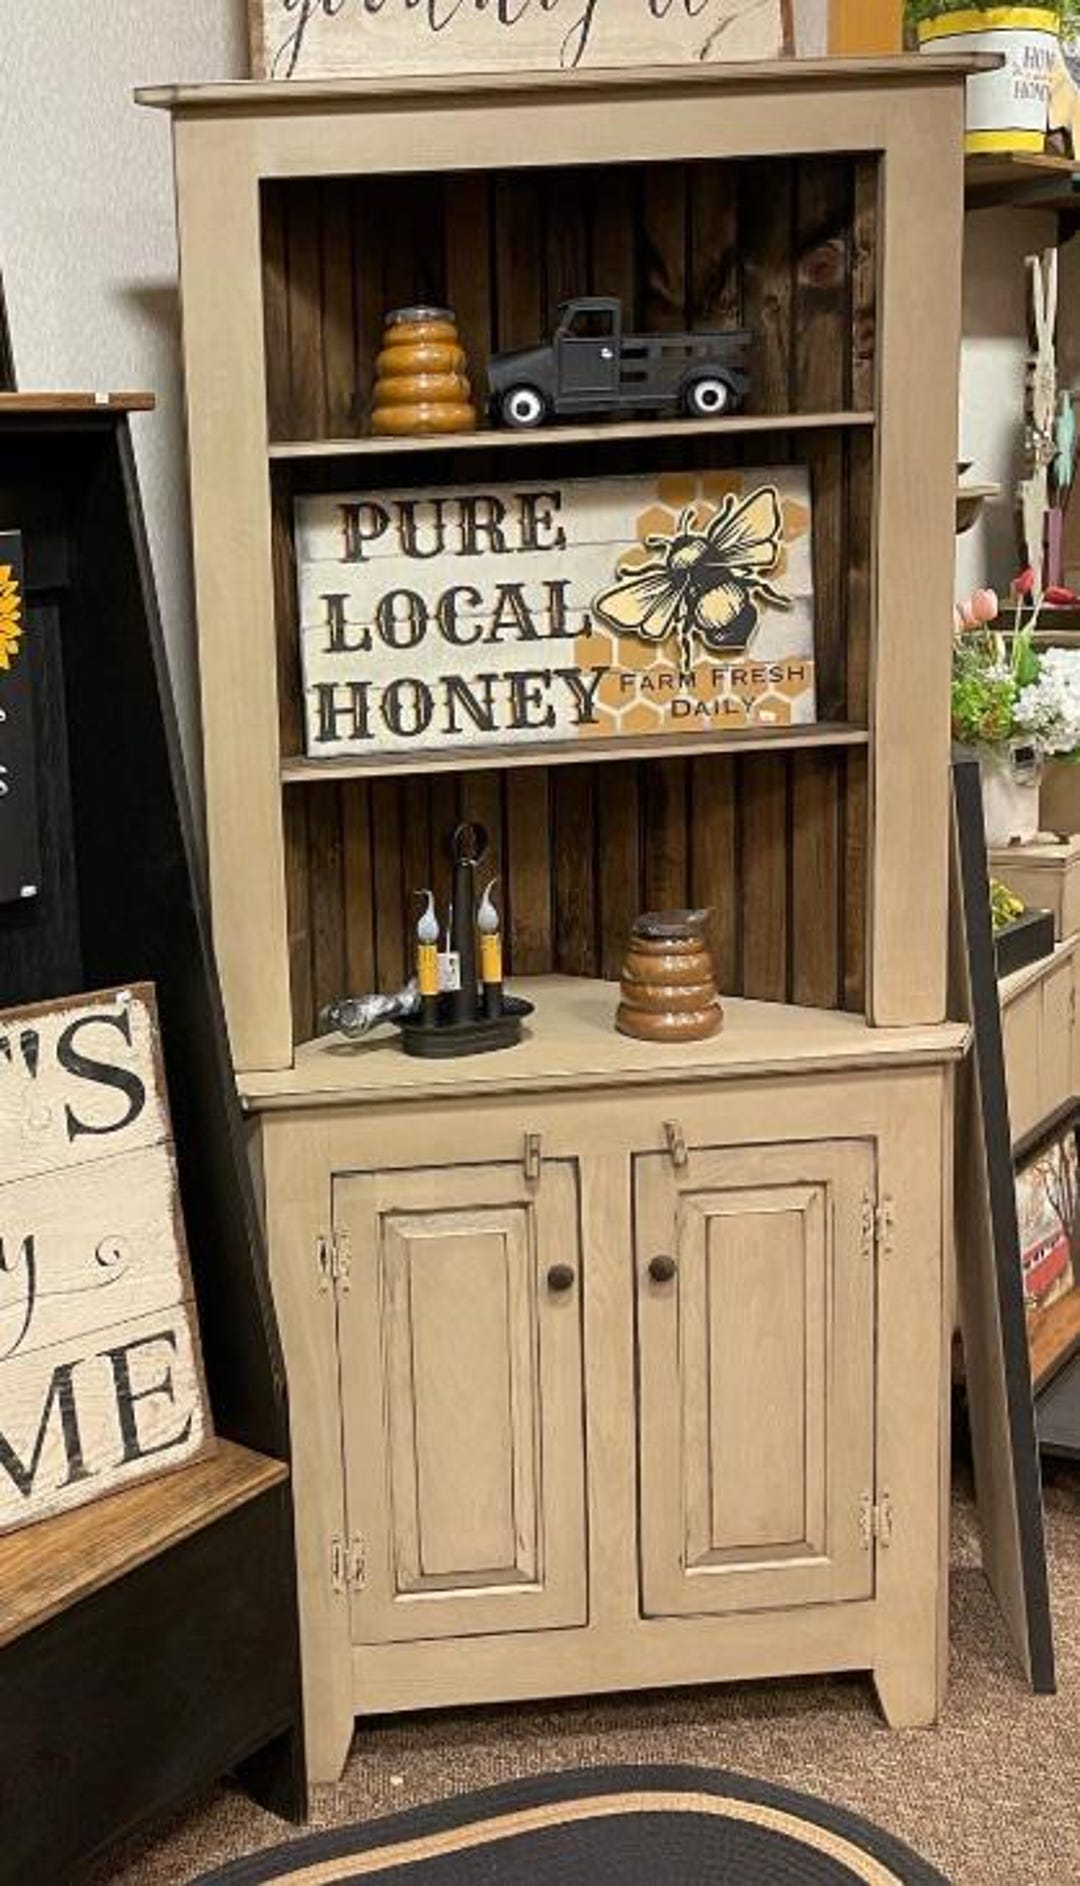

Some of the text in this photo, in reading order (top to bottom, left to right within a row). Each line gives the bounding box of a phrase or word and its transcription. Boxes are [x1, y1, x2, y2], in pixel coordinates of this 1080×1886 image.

[336, 490, 566, 564] PURE
[319, 579, 592, 654] LOCAL
[312, 666, 610, 743] HONEY
[619, 665, 805, 693] FARM FRESH
[671, 697, 756, 719] DAILY
